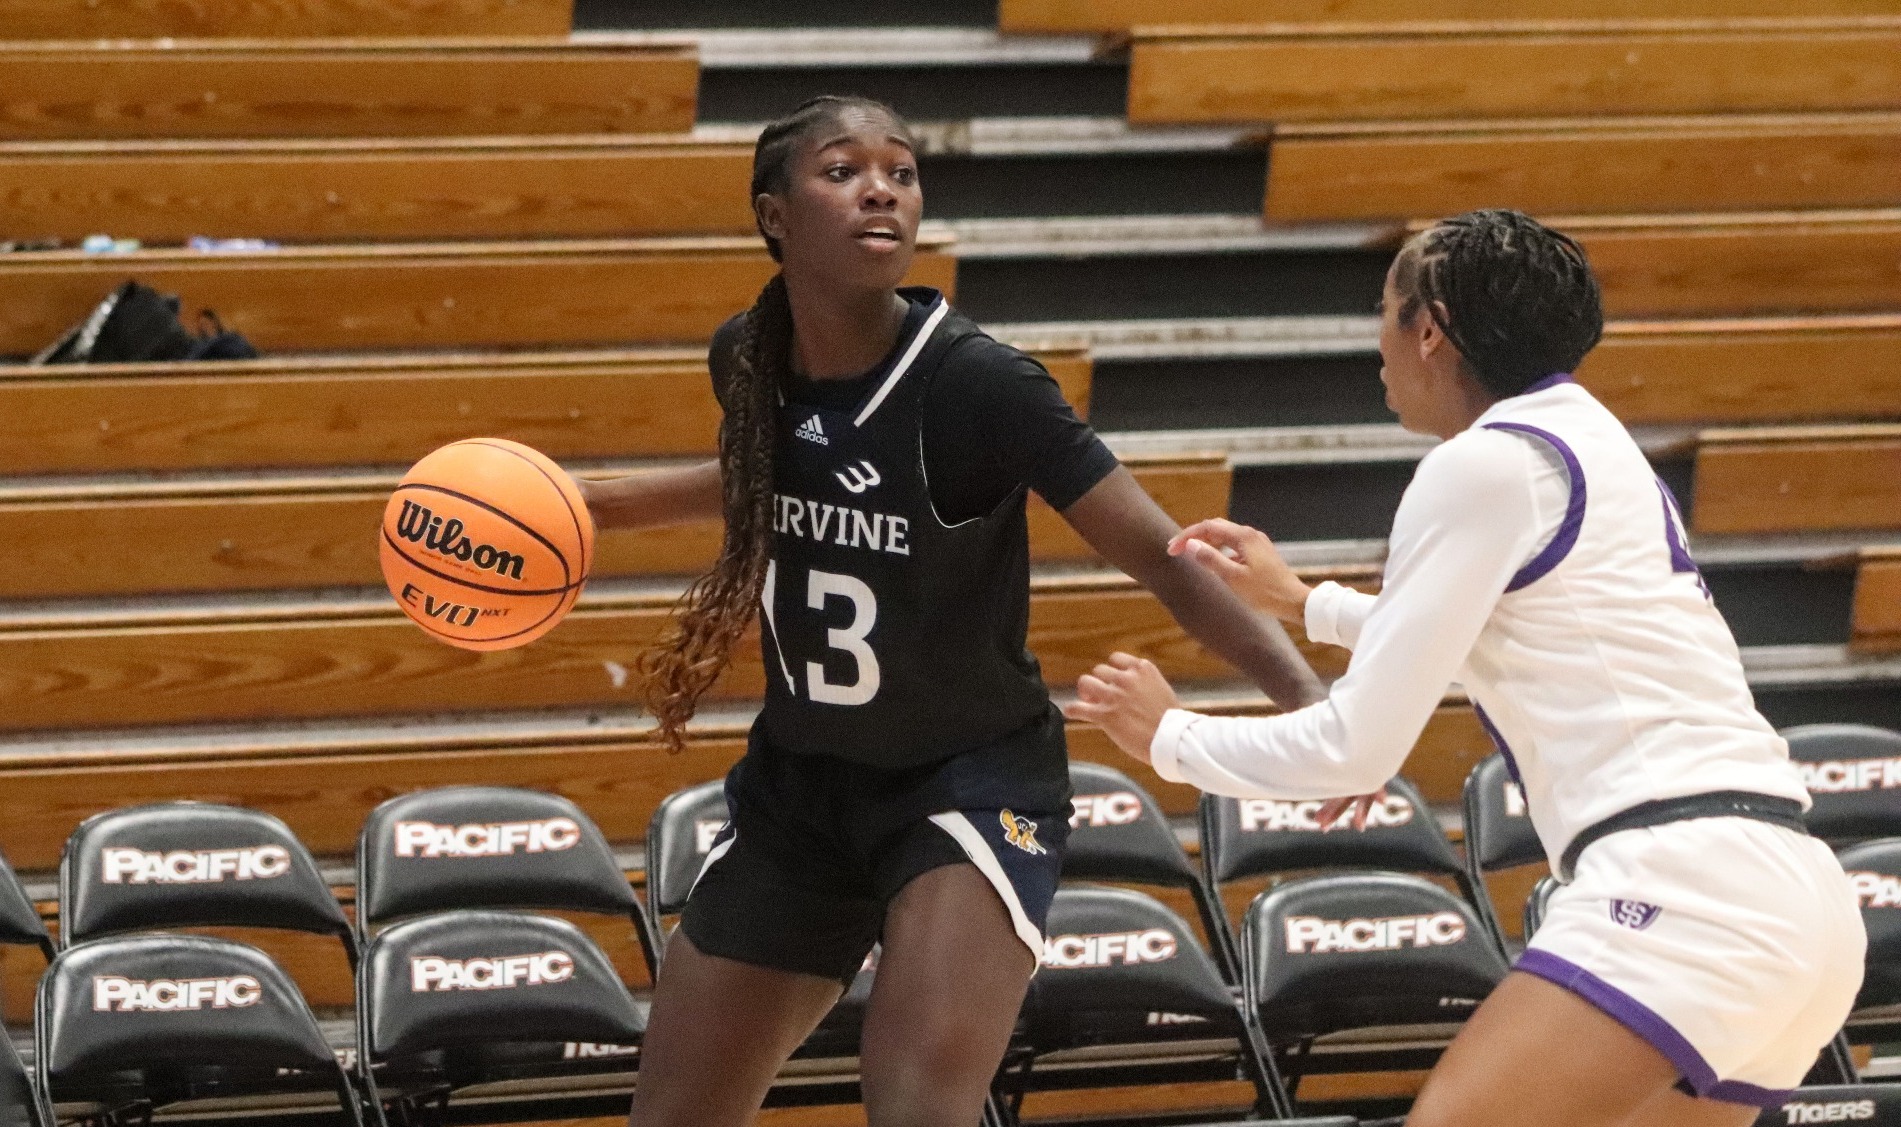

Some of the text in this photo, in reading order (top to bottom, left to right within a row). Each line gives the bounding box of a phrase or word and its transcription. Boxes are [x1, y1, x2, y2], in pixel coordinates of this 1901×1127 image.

[795, 428, 829, 446] adidas
[397, 499, 525, 581] Wilson
[1800, 758, 1901, 792] ACIFI
[396, 818, 581, 857] PACIFIC
[103, 845, 290, 884] PACIFIC
[1285, 912, 1466, 953] PACIFIC
[411, 951, 575, 992] PACIFIC
[93, 975, 262, 1011] PACIFIC
[1781, 1099, 1876, 1125] TIGERS
